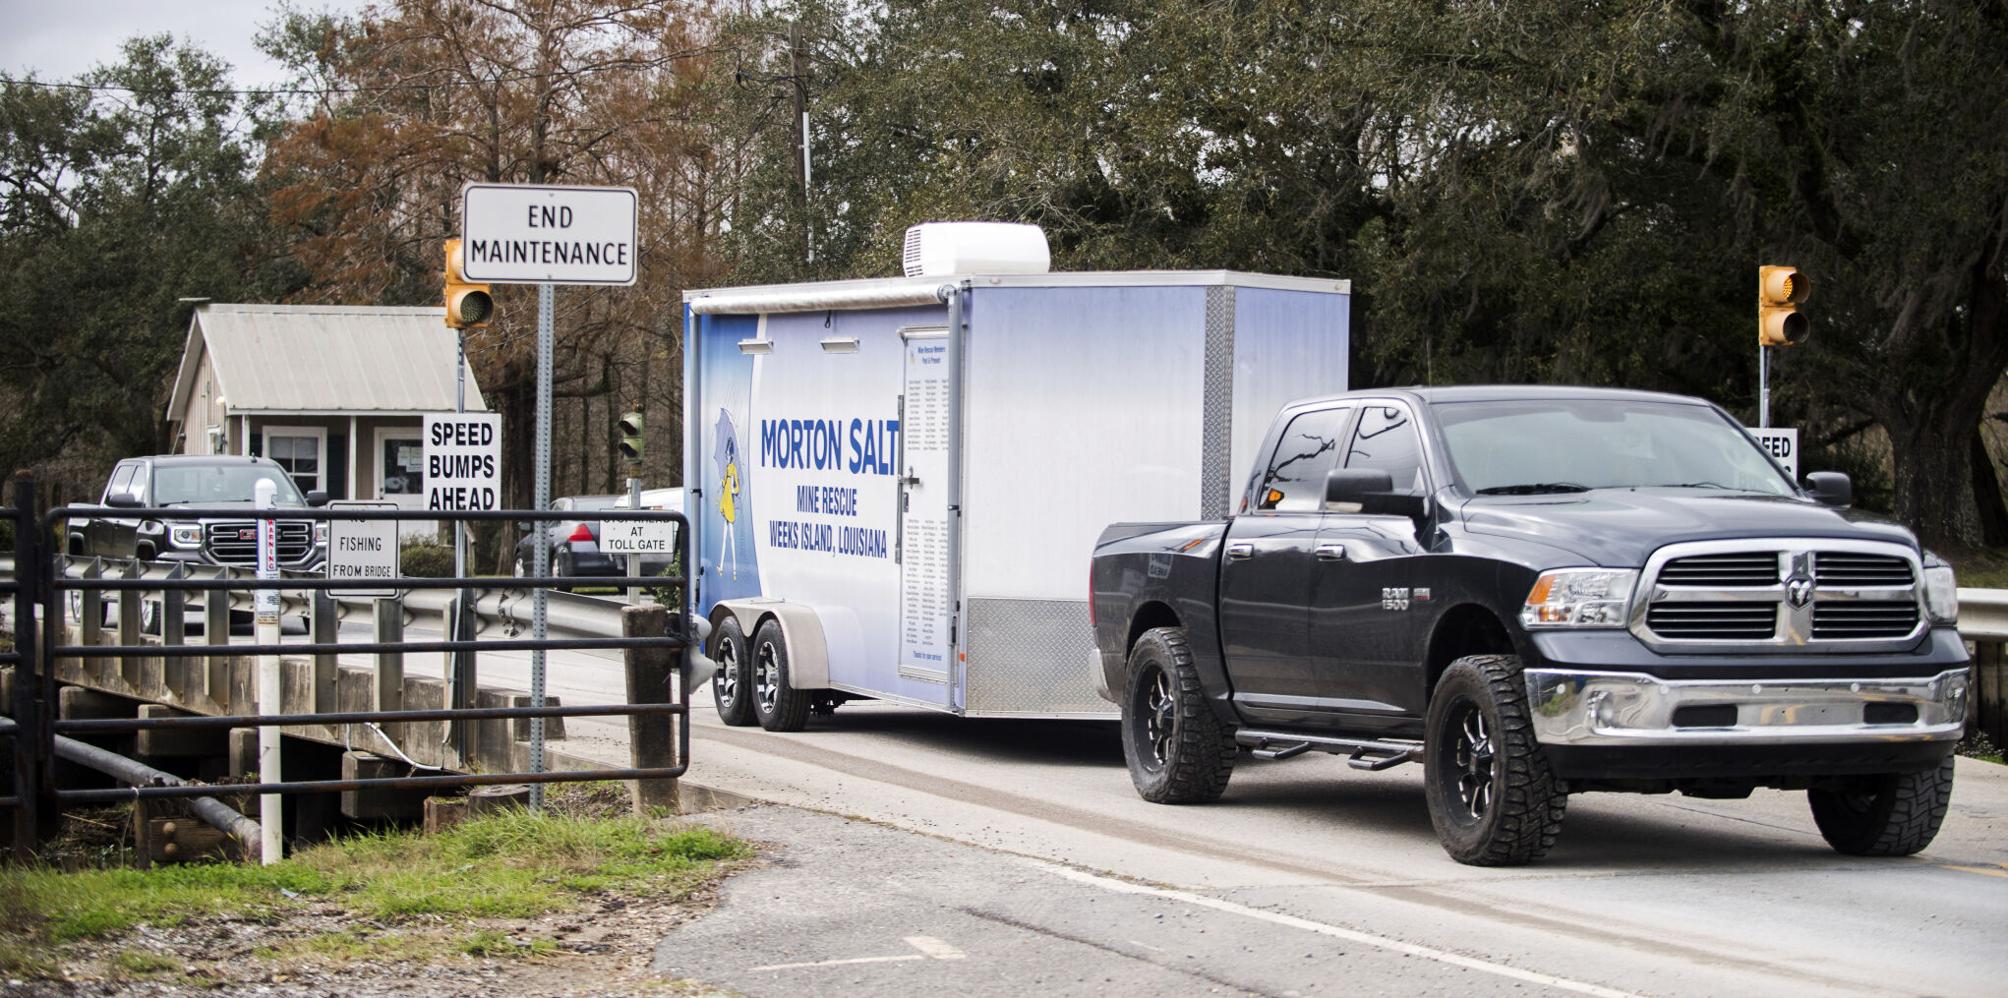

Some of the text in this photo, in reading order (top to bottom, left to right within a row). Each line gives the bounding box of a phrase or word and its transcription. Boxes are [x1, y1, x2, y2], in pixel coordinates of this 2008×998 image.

[528, 205, 573, 228] END
[472, 240, 627, 265] MAINTENANCE
[431, 422, 493, 446] SPEED
[761, 418, 900, 475] MORTON SALT
[1755, 436, 1791, 457] EED
[430, 455, 494, 478] BUMPS
[429, 487, 494, 511] AHEAD
[797, 485, 857, 516] MINE RESCUE
[631, 527, 643, 536] AT
[769, 520, 887, 558] WEEKS ISLAND, LOUISIANA
[340, 537, 382, 551] FISHING
[609, 540, 665, 550] TOLL GATE
[333, 565, 391, 577] FROM BRIDGE
